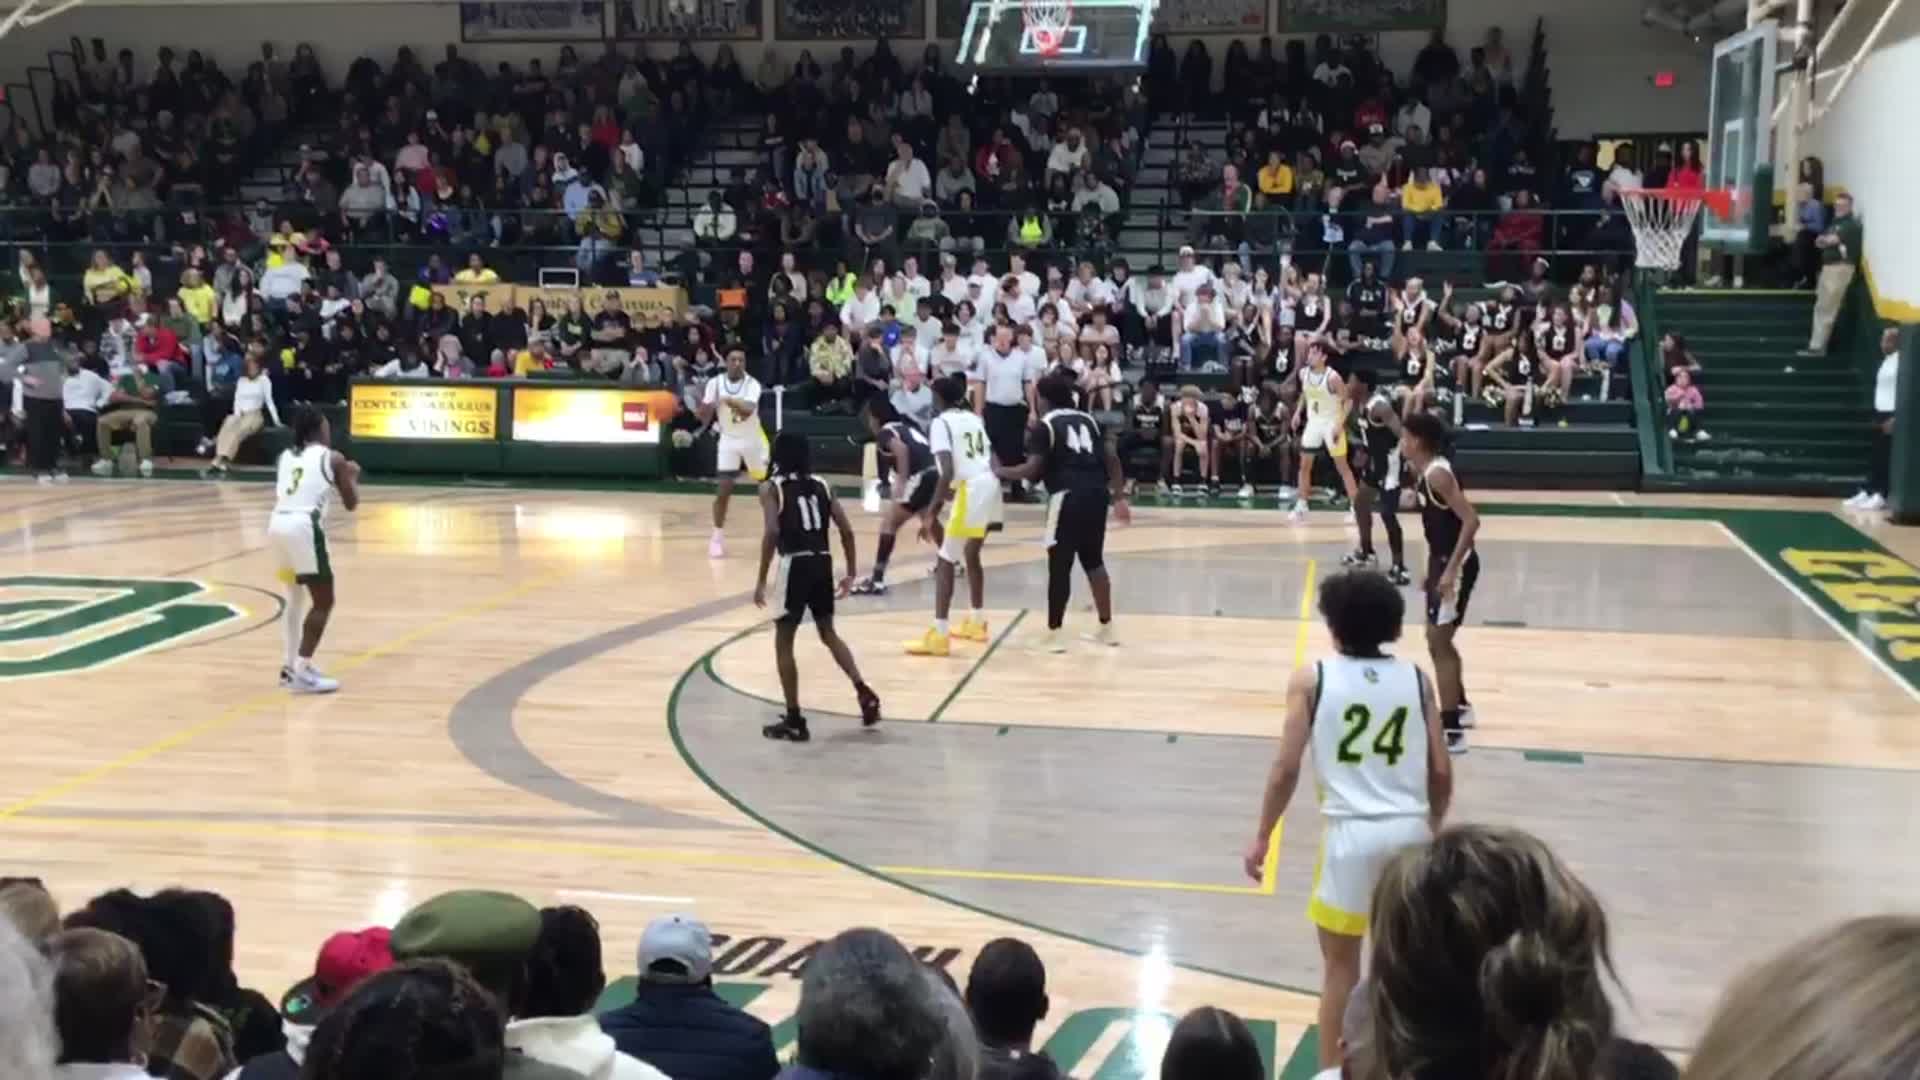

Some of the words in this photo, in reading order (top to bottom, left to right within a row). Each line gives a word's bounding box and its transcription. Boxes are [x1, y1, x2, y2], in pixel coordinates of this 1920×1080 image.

[354, 399, 415, 410] CENTRA
[420, 400, 491, 412] ABARRUS
[409, 420, 490, 434] VIKINGS
[963, 430, 985, 459] 34
[286, 467, 304, 495] 3
[797, 494, 822, 531] 11
[1337, 702, 1409, 767] 24
